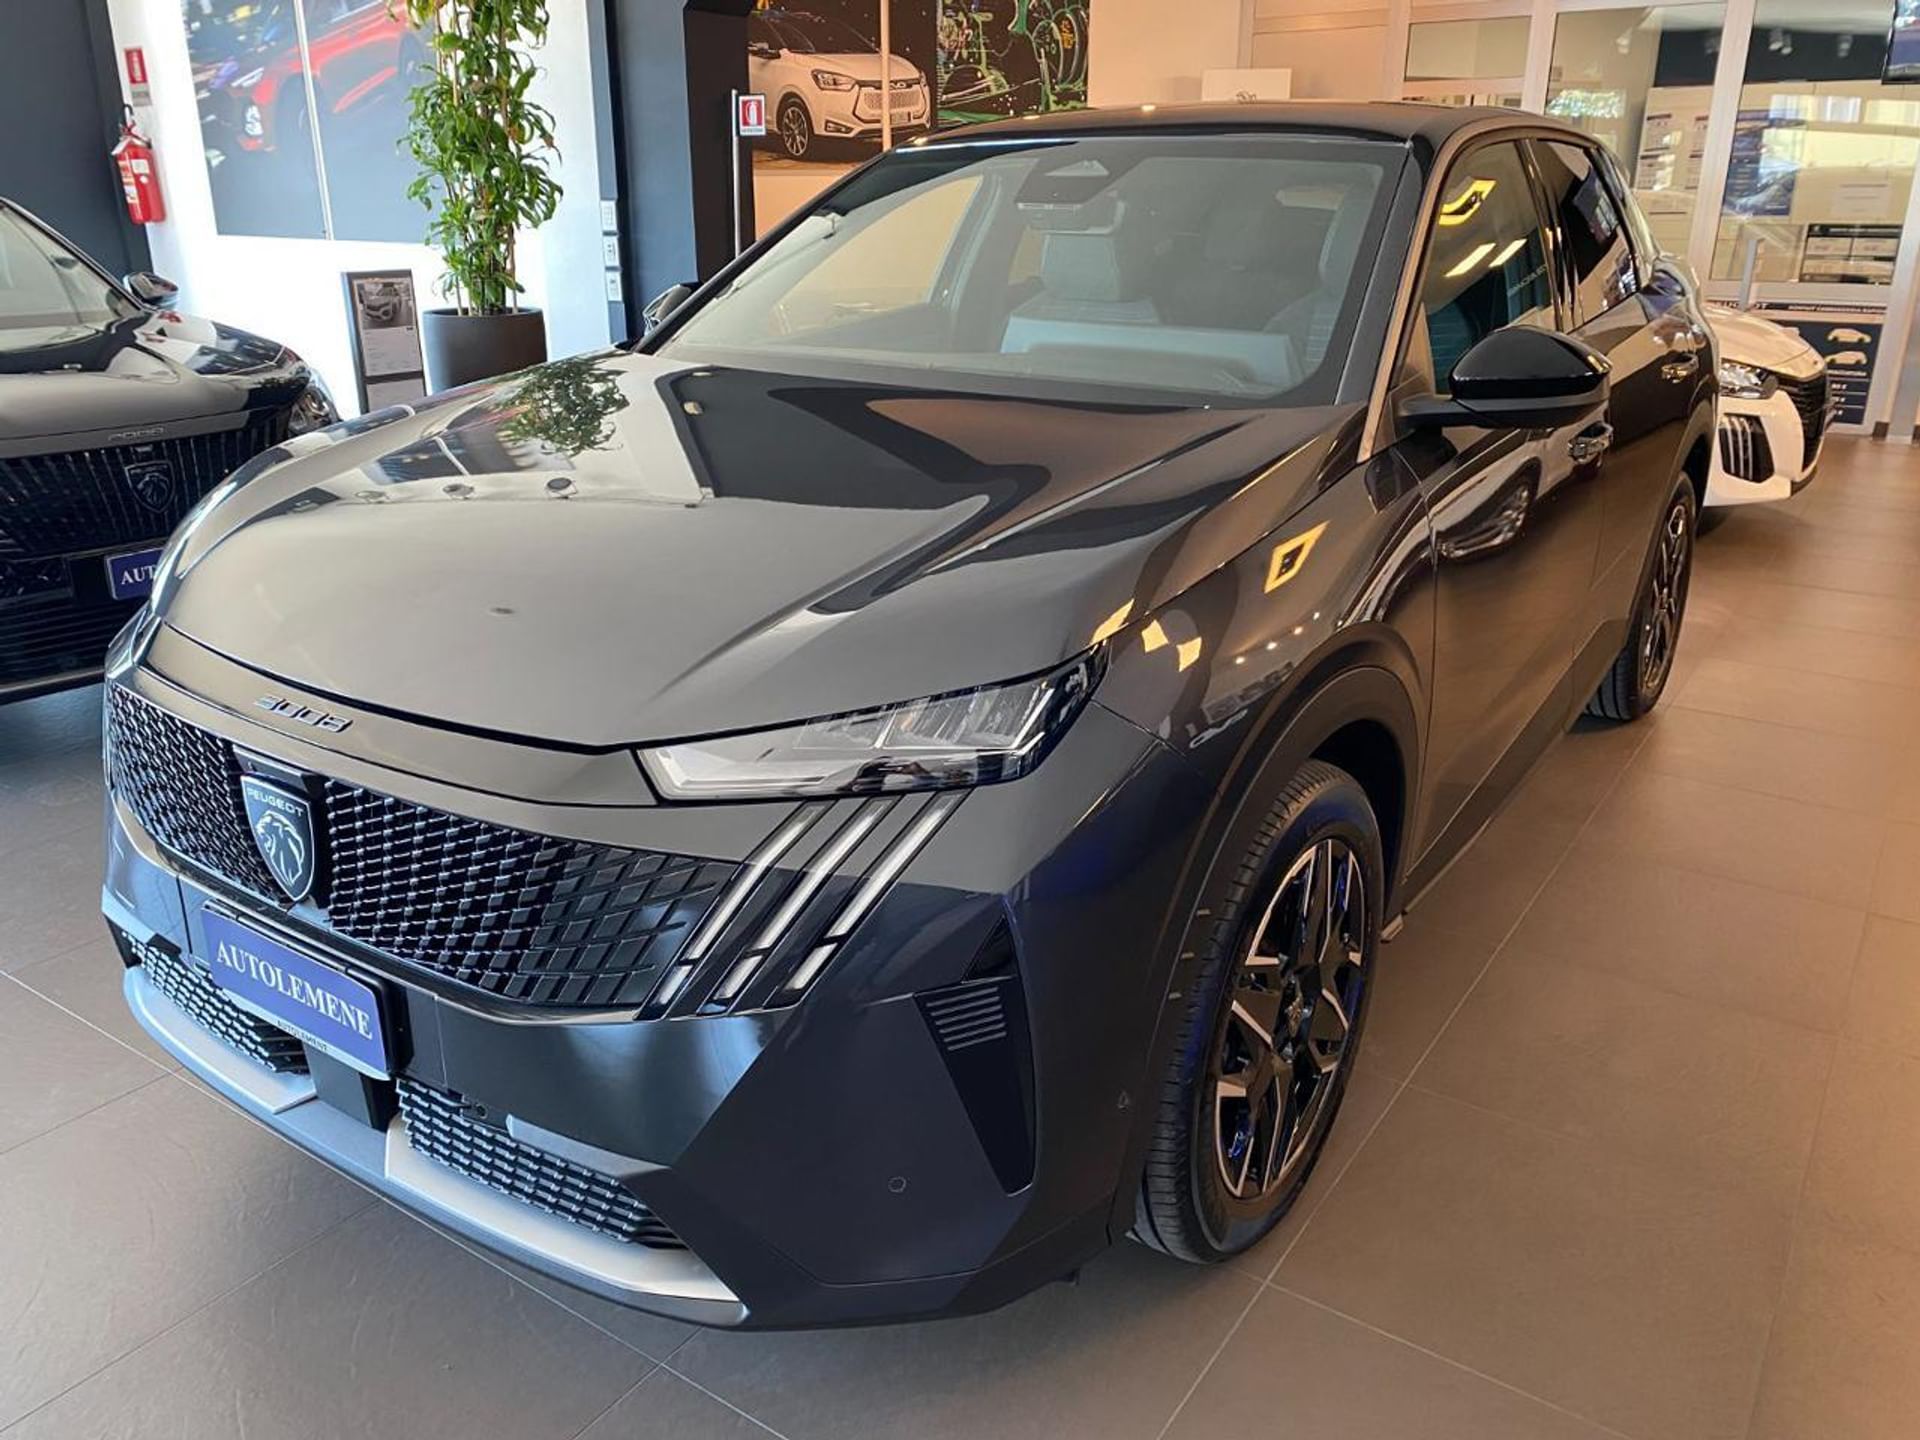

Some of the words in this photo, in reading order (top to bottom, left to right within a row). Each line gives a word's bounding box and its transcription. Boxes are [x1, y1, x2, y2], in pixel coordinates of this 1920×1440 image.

[254, 696, 353, 733] 3008
[246, 786, 304, 817] PEUGEOT
[216, 940, 373, 1041] AUTOLEMENE
